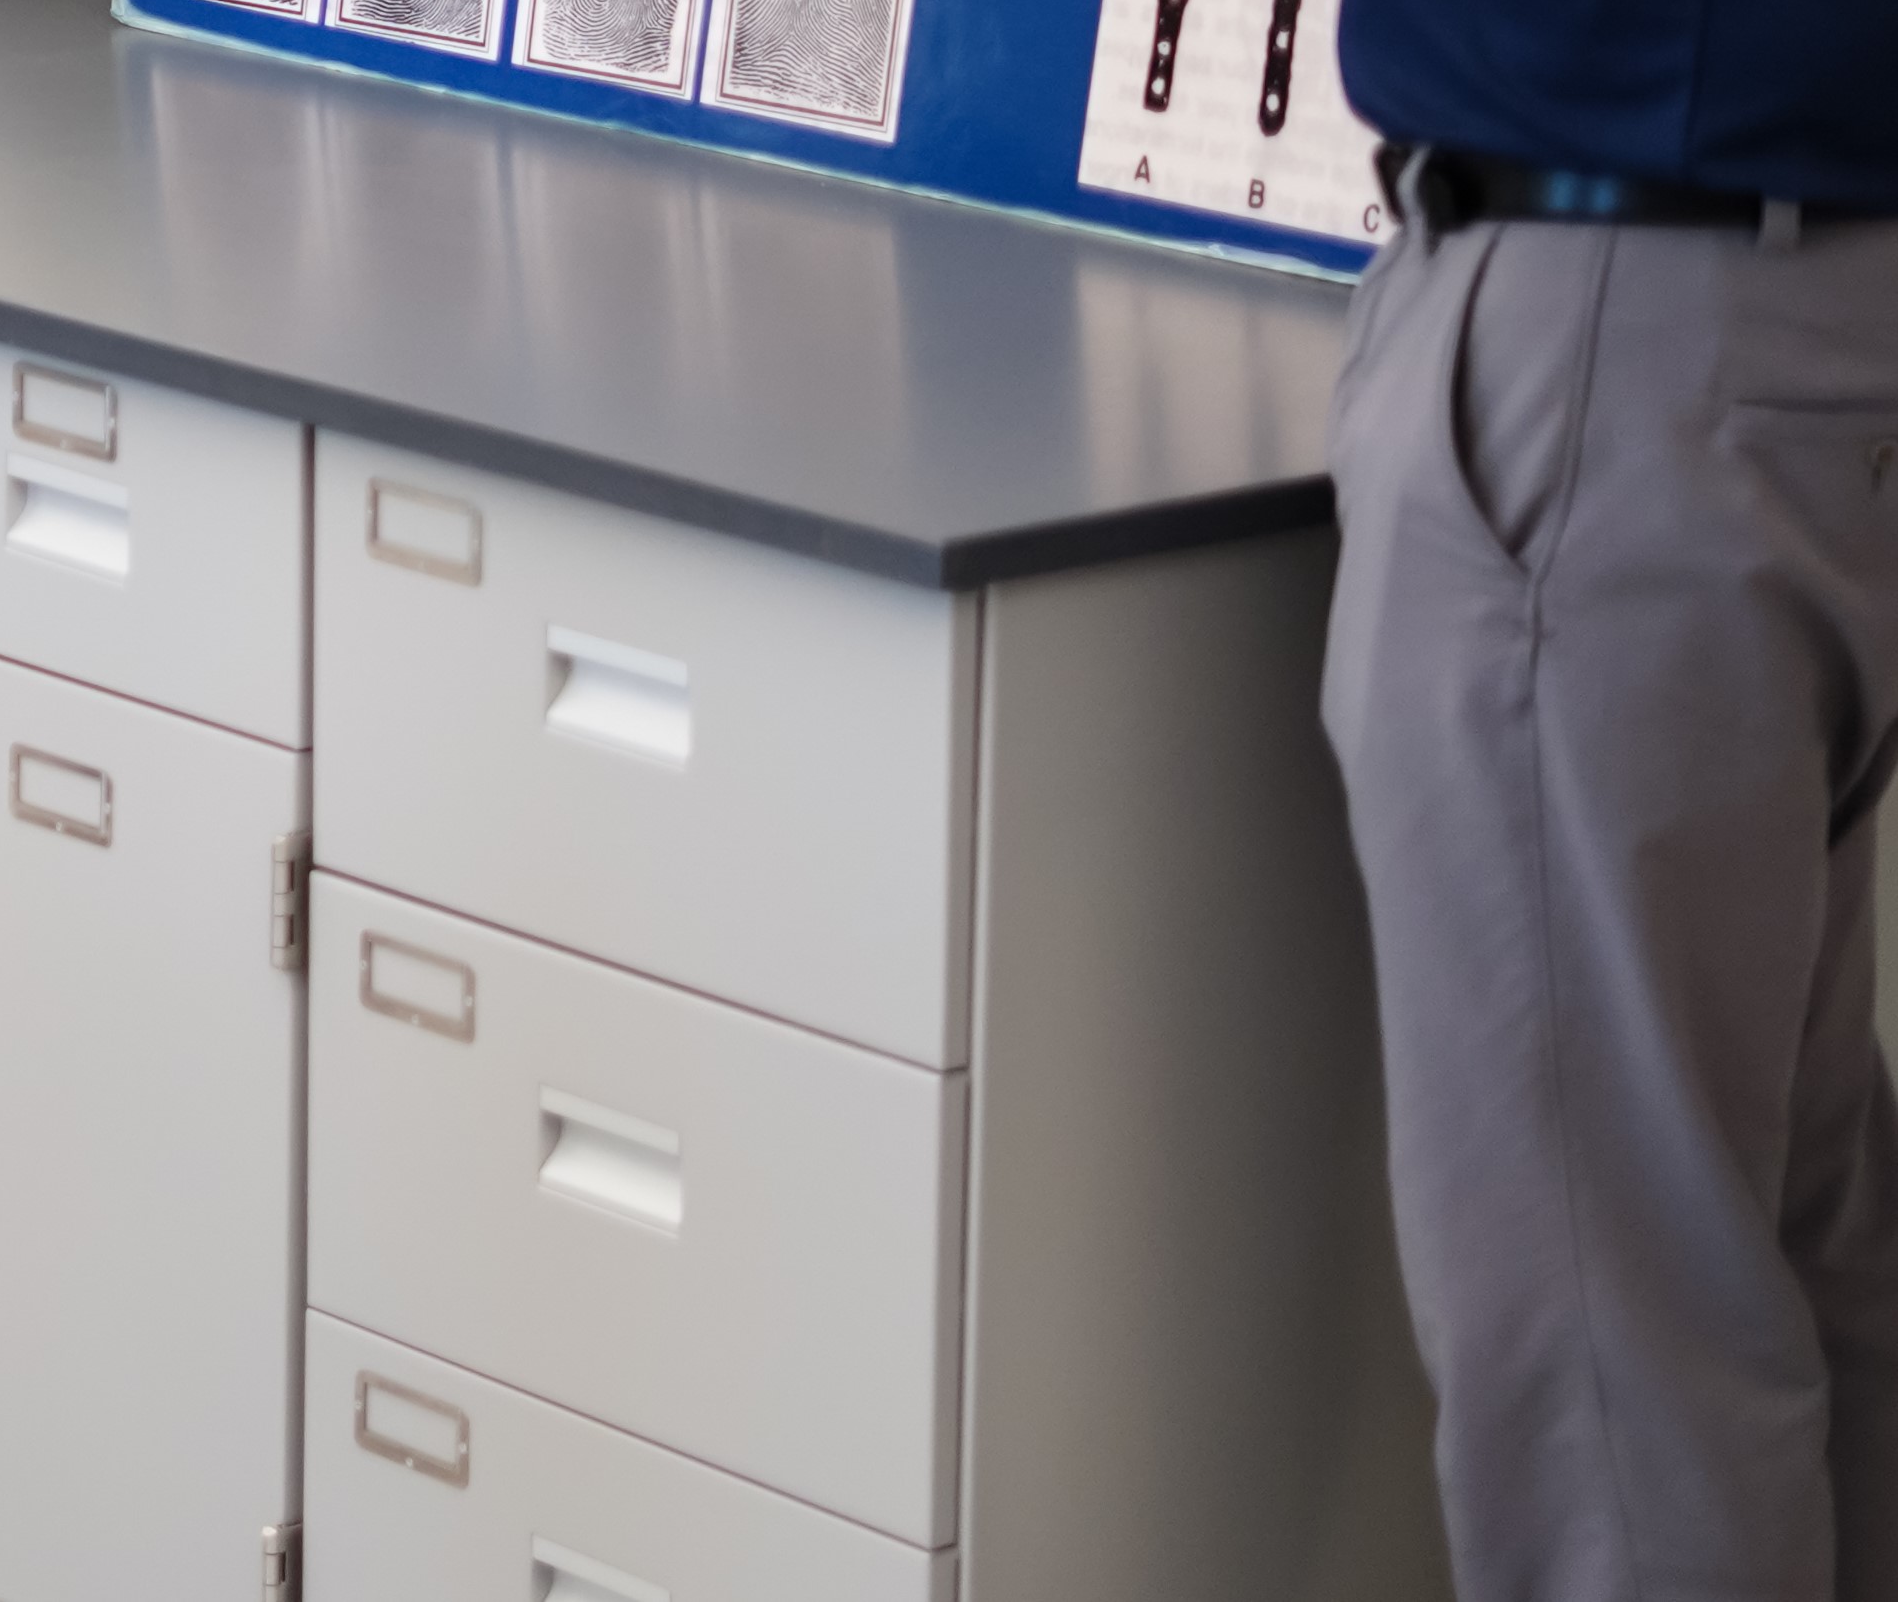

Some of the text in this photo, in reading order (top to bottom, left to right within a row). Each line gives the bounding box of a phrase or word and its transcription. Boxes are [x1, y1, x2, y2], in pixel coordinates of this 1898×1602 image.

[1134, 154, 1380, 233] A B C
